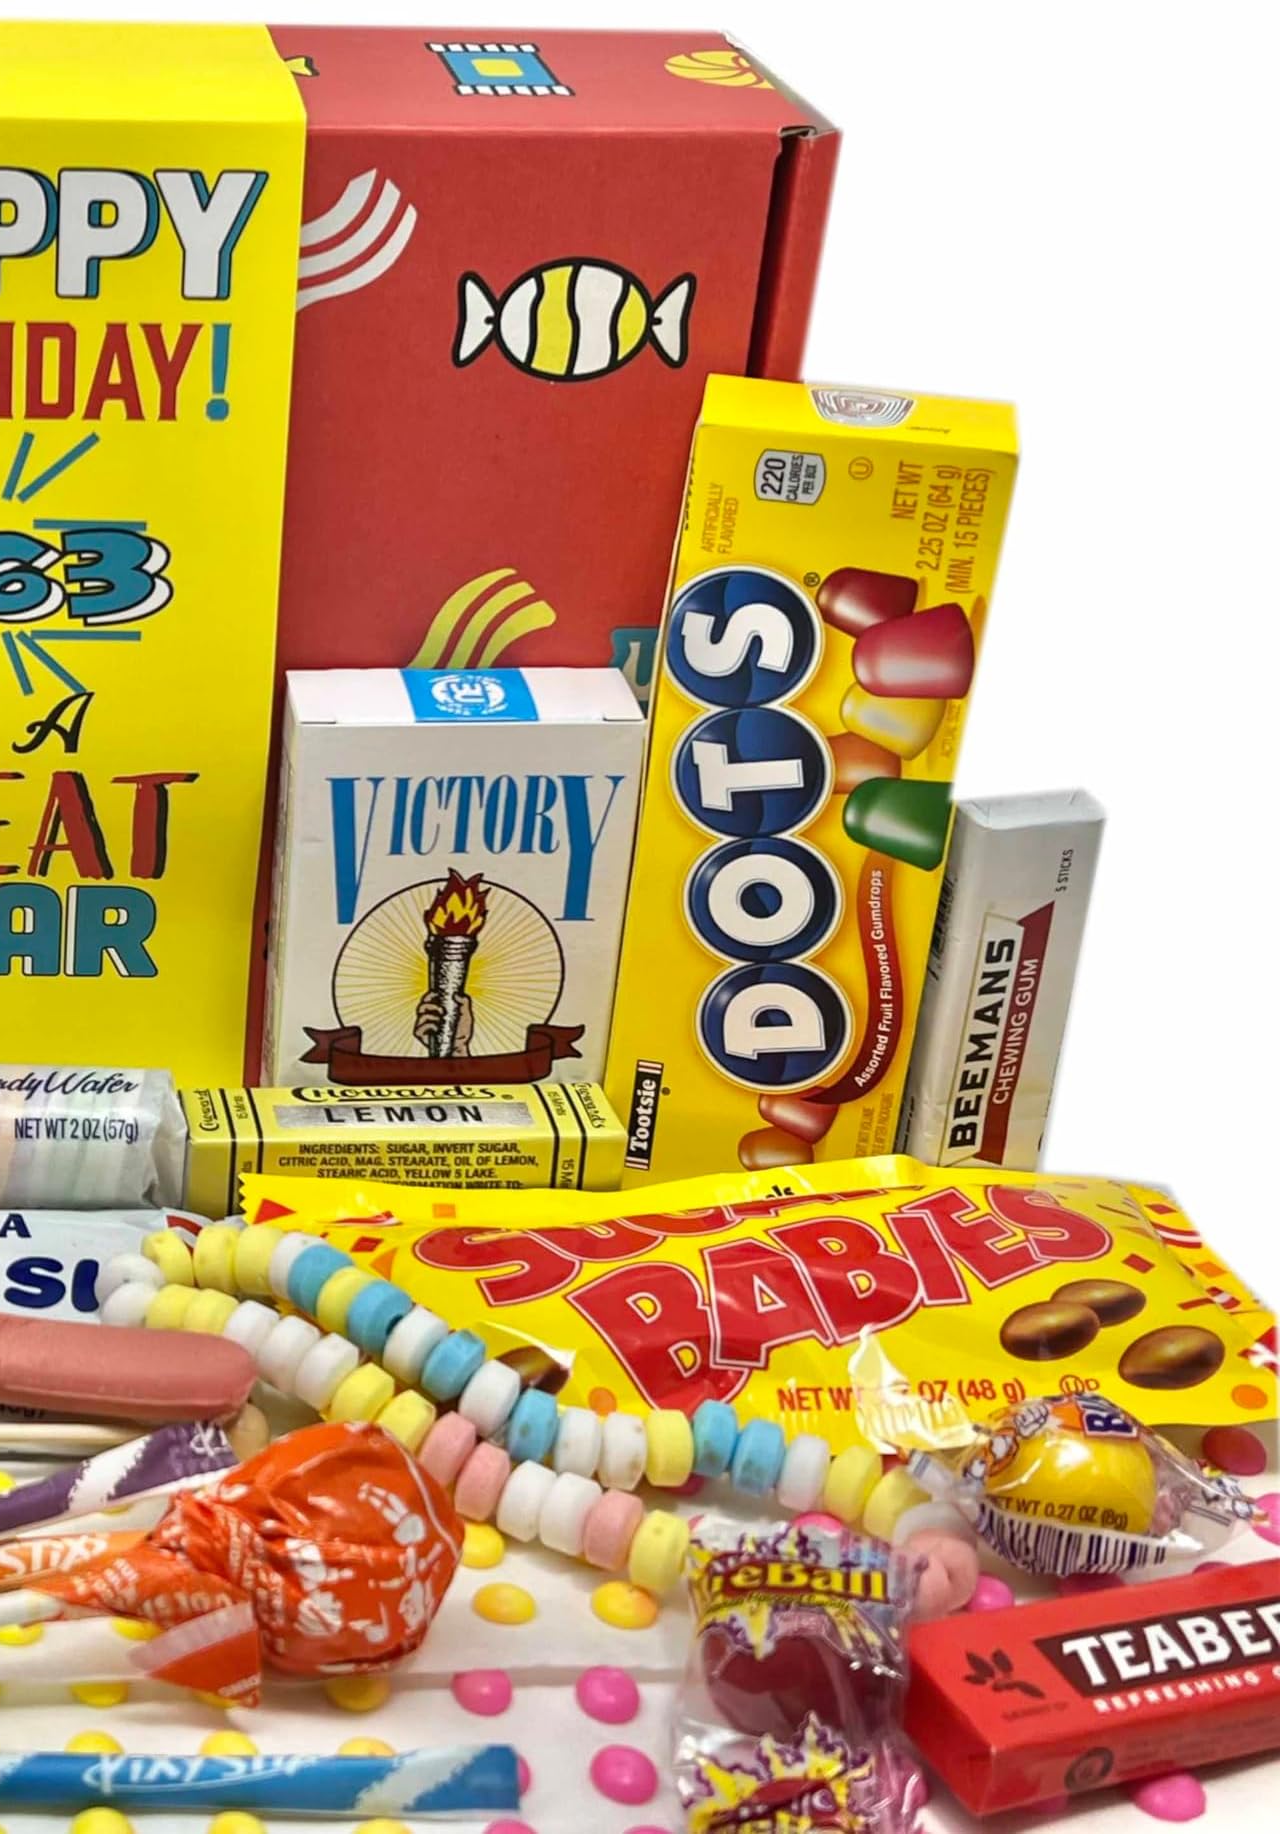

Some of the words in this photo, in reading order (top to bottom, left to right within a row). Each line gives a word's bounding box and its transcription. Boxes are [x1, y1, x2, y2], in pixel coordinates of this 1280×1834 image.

[760, 457, 787, 496] 220
[786, 453, 804, 501] CALORIES
[802, 480, 815, 496] PER
[896, 460, 924, 486] WT
[932, 464, 962, 480] g)
[890, 488, 918, 520] NET
[928, 484, 956, 509] (64
[956, 467, 997, 527] PIECES)
[701, 482, 724, 554] ARTIFICIALLY
[717, 497, 739, 555] FLAVORED
[922, 511, 949, 533] OZ
[915, 537, 944, 571] 2.25
[954, 531, 979, 548] 15
[945, 556, 975, 594] (MIN.
[12, 691, 95, 754] A
[325, 773, 626, 925] VICTORY
[681, 602, 826, 1060] DOTS
[1056, 848, 1074, 884] STICKS
[869, 869, 884, 940] Gumdrops
[872, 943, 893, 999] Flavored
[877, 1000, 894, 1033] Fruit
[992, 1010, 1027, 1105] CHEWING
[1015, 958, 1039, 1006] GUM
[854, 1033, 888, 1088] Assorted
[948, 937, 1016, 1150] BEEMANS
[44, 1071, 140, 1095] Wafer
[14, 1117, 42, 1139] NET
[44, 1117, 68, 1139] WT
[70, 1118, 80, 1138] 2
[82, 1118, 102, 1138] OZ
[102, 1117, 139, 1144] (57g)
[324, 1105, 484, 1123] LEMON
[629, 1074, 658, 1154] Tootsie
[278, 1155, 318, 1167] CITRIC
[320, 1156, 351, 1167] ACID,
[354, 1156, 385, 1167] MAG.
[387, 1155, 451, 1168] STEARATE,
[475, 1155, 492, 1167] OF
[494, 1154, 540, 1167] LEMON,
[299, 1143, 380, 1155] INGREDIENTS:
[386, 1143, 430, 1155] SUGAR,
[433, 1143, 475, 1154] INVERT
[478, 1143, 521, 1154] SUGAR,
[317, 1168, 367, 1179] STEARIC
[370, 1168, 401, 1179] ACID,
[404, 1168, 452, 1179] YELLOW
[454, 1168, 462, 1179] 5
[465, 1168, 498, 1179] LAKE.
[567, 1185, 1115, 1413] BABIES
[777, 1386, 823, 1412] NET
[957, 1379, 997, 1407] (48
[1002, 1377, 1026, 1405] g)
[1017, 1497, 1041, 1515] WT
[1044, 1502, 1075, 1519] 0.27
[1078, 1505, 1097, 1522] OZ
[1093, 1669, 1261, 1714] REFRESHING
